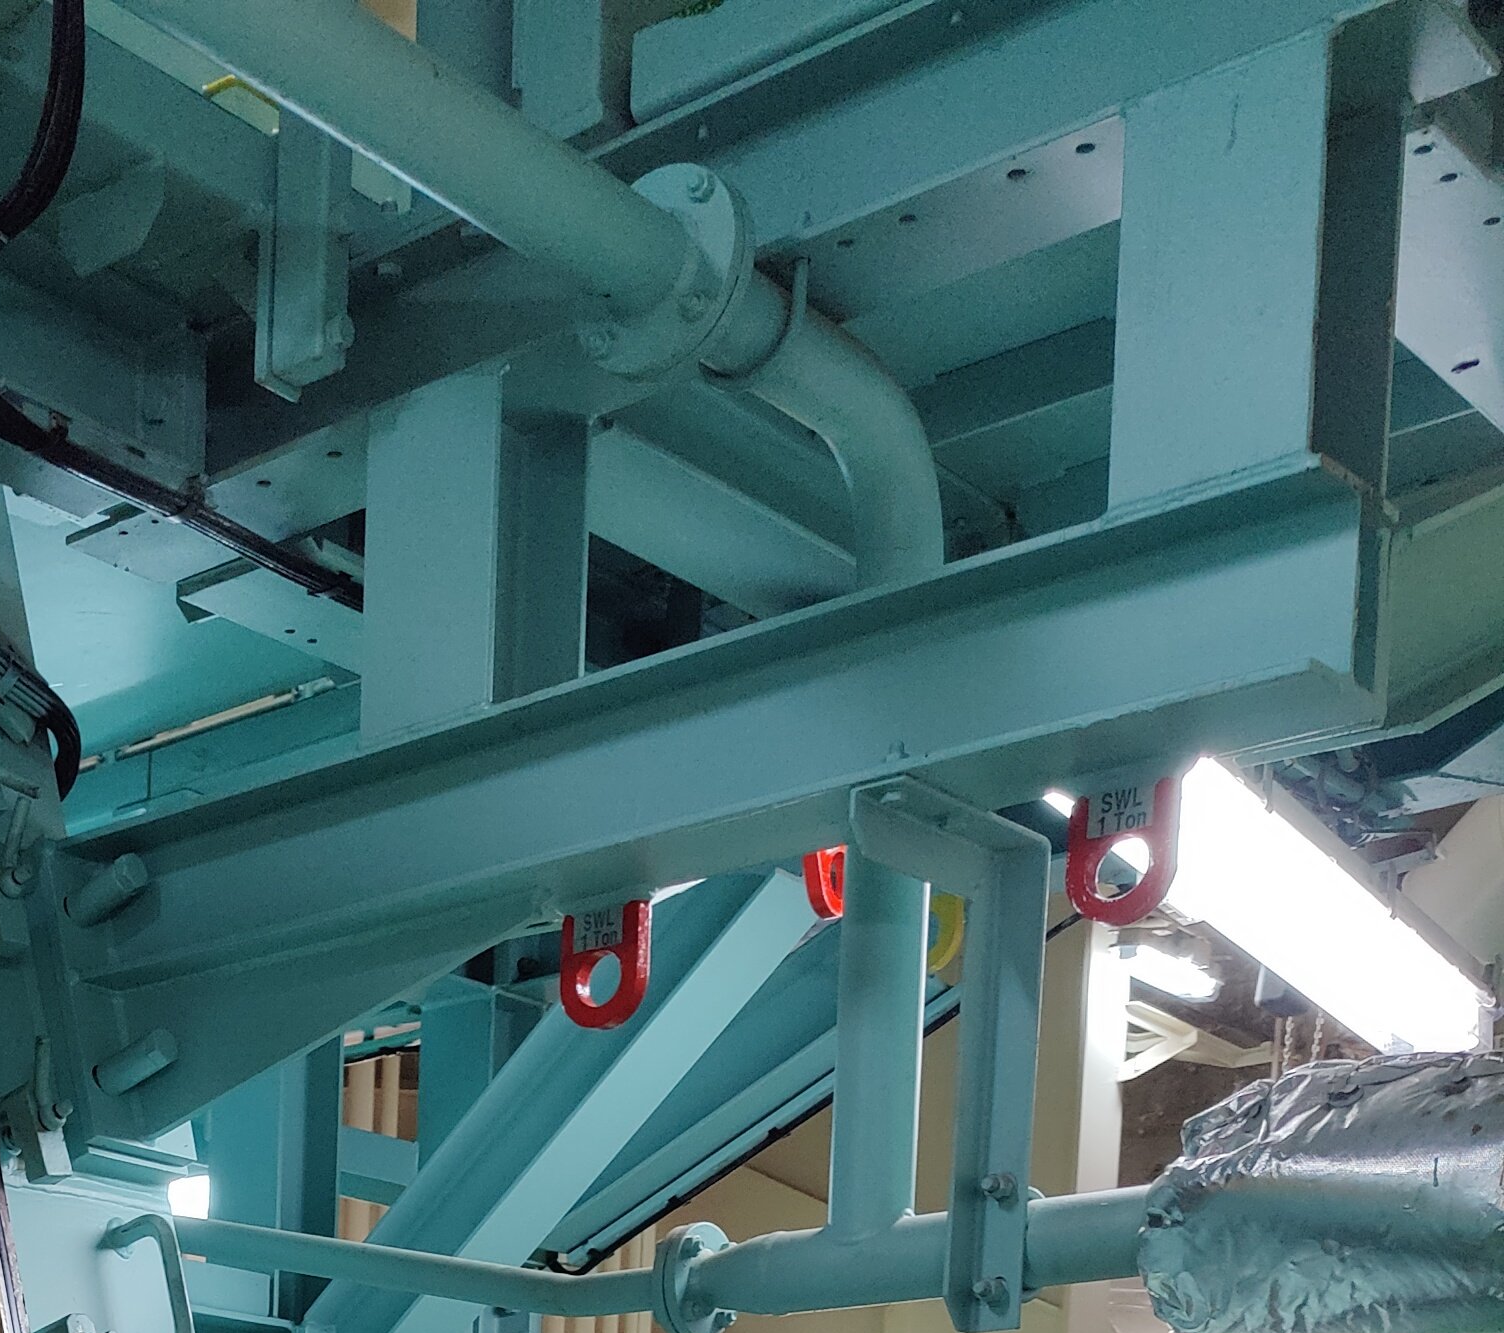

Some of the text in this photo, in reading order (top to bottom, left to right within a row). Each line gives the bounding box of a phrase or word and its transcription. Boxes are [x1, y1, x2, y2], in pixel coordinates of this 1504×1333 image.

[1101, 787, 1143, 814] SWL
[1097, 811, 1147, 835] 1 Ton
[583, 909, 615, 931] SWL
[581, 930, 618, 950] 1 Ton
